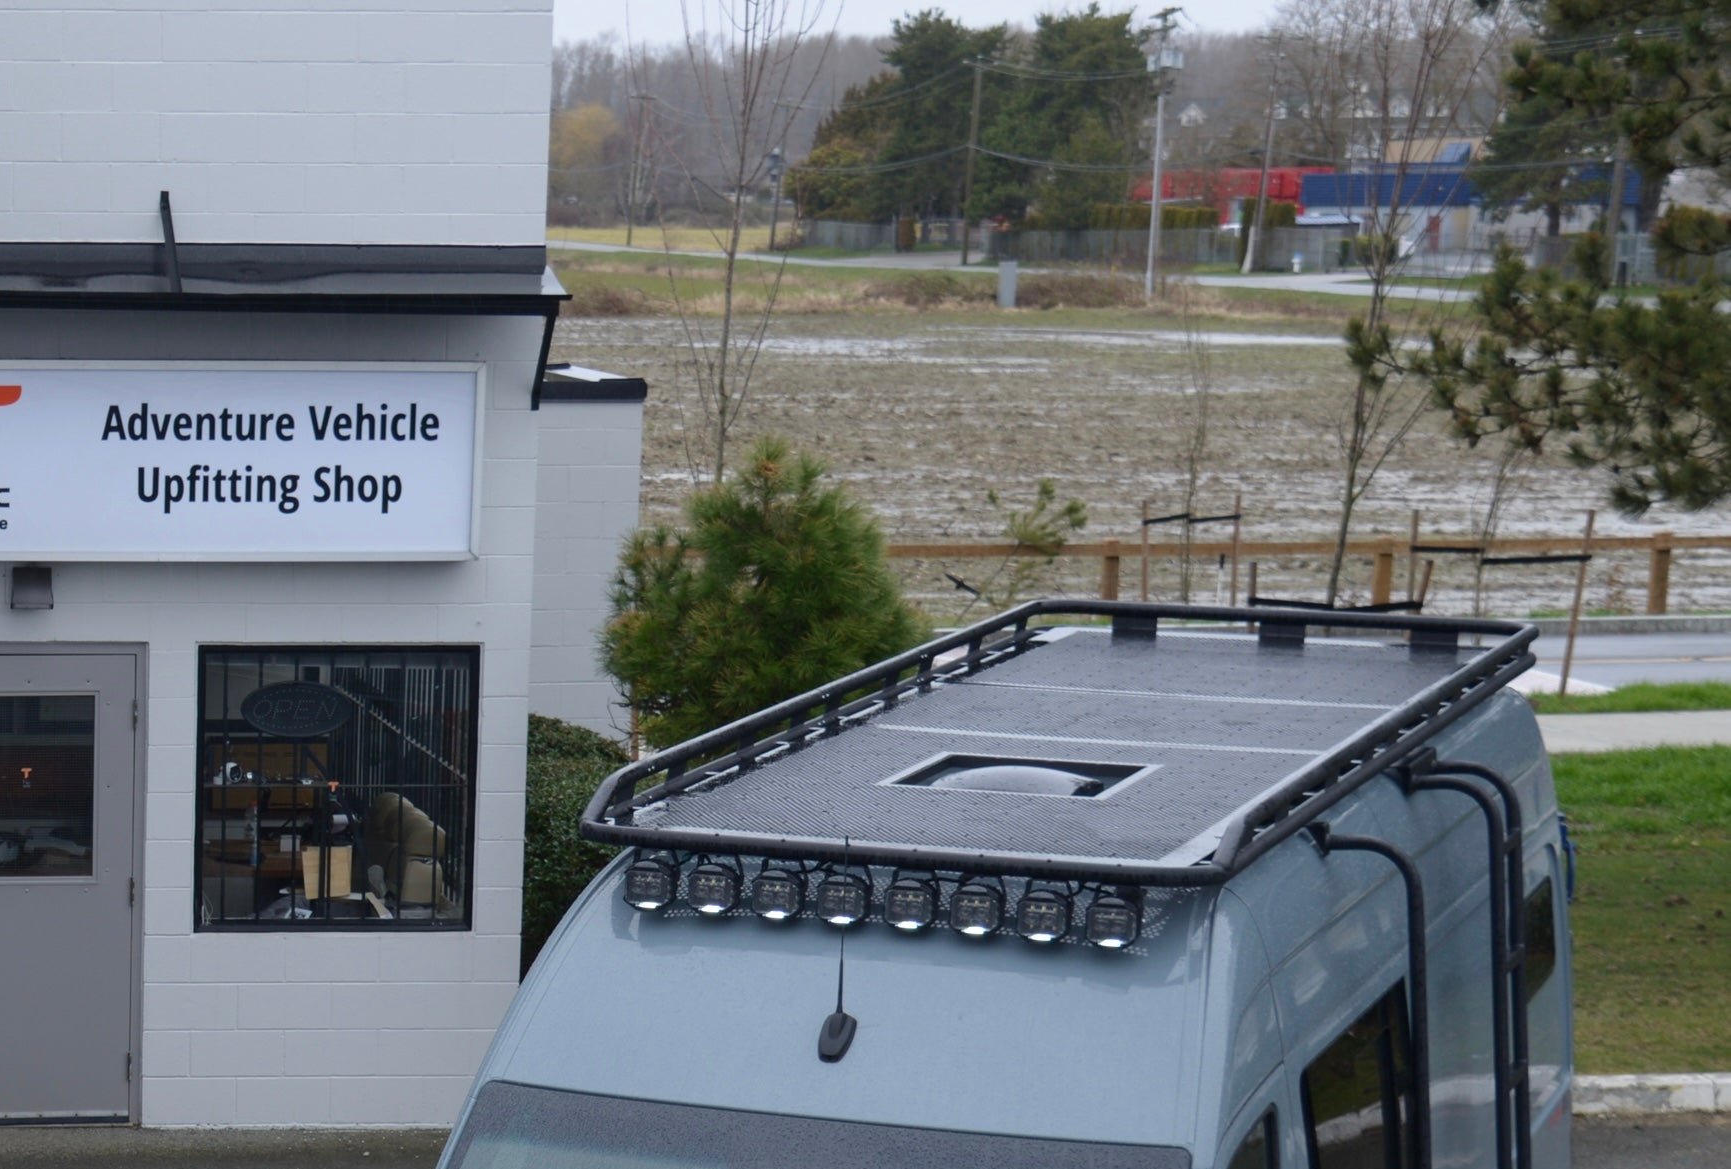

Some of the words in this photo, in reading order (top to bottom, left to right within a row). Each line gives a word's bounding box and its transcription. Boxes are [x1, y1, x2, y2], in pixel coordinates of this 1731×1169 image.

[102, 403, 295, 442] Adventure
[308, 403, 440, 442] Vehicle
[136, 465, 300, 514] Upfitting
[313, 465, 403, 514] Shop
[253, 699, 339, 720] OPEN
